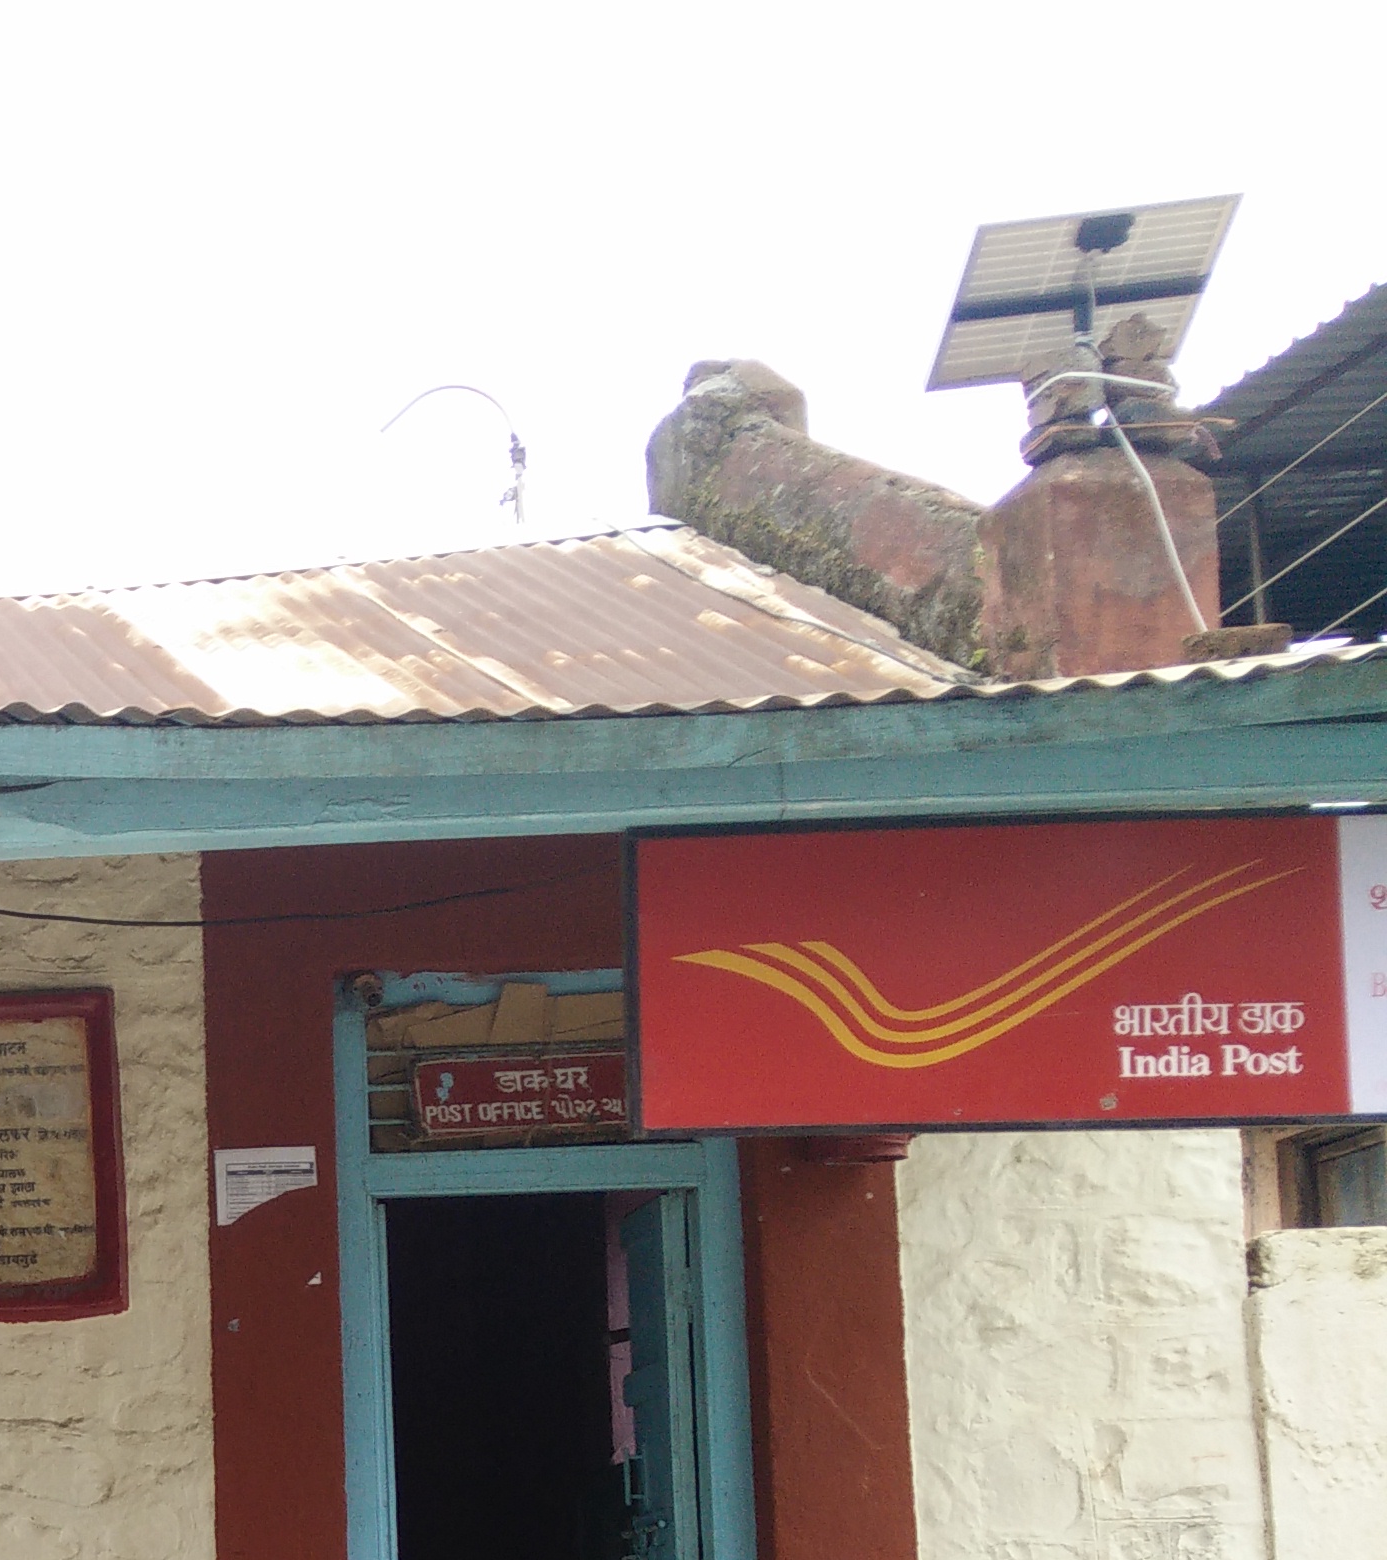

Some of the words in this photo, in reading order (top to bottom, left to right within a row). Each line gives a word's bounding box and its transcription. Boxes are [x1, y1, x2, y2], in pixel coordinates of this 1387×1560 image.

[1113, 992, 1234, 1038] भारतीय
[1238, 1001, 1305, 1037] डाक
[1119, 1044, 1211, 1078] India
[1221, 1043, 1304, 1076] Post
[425, 1103, 473, 1125] POST
[478, 1100, 545, 1122] OFFICE
